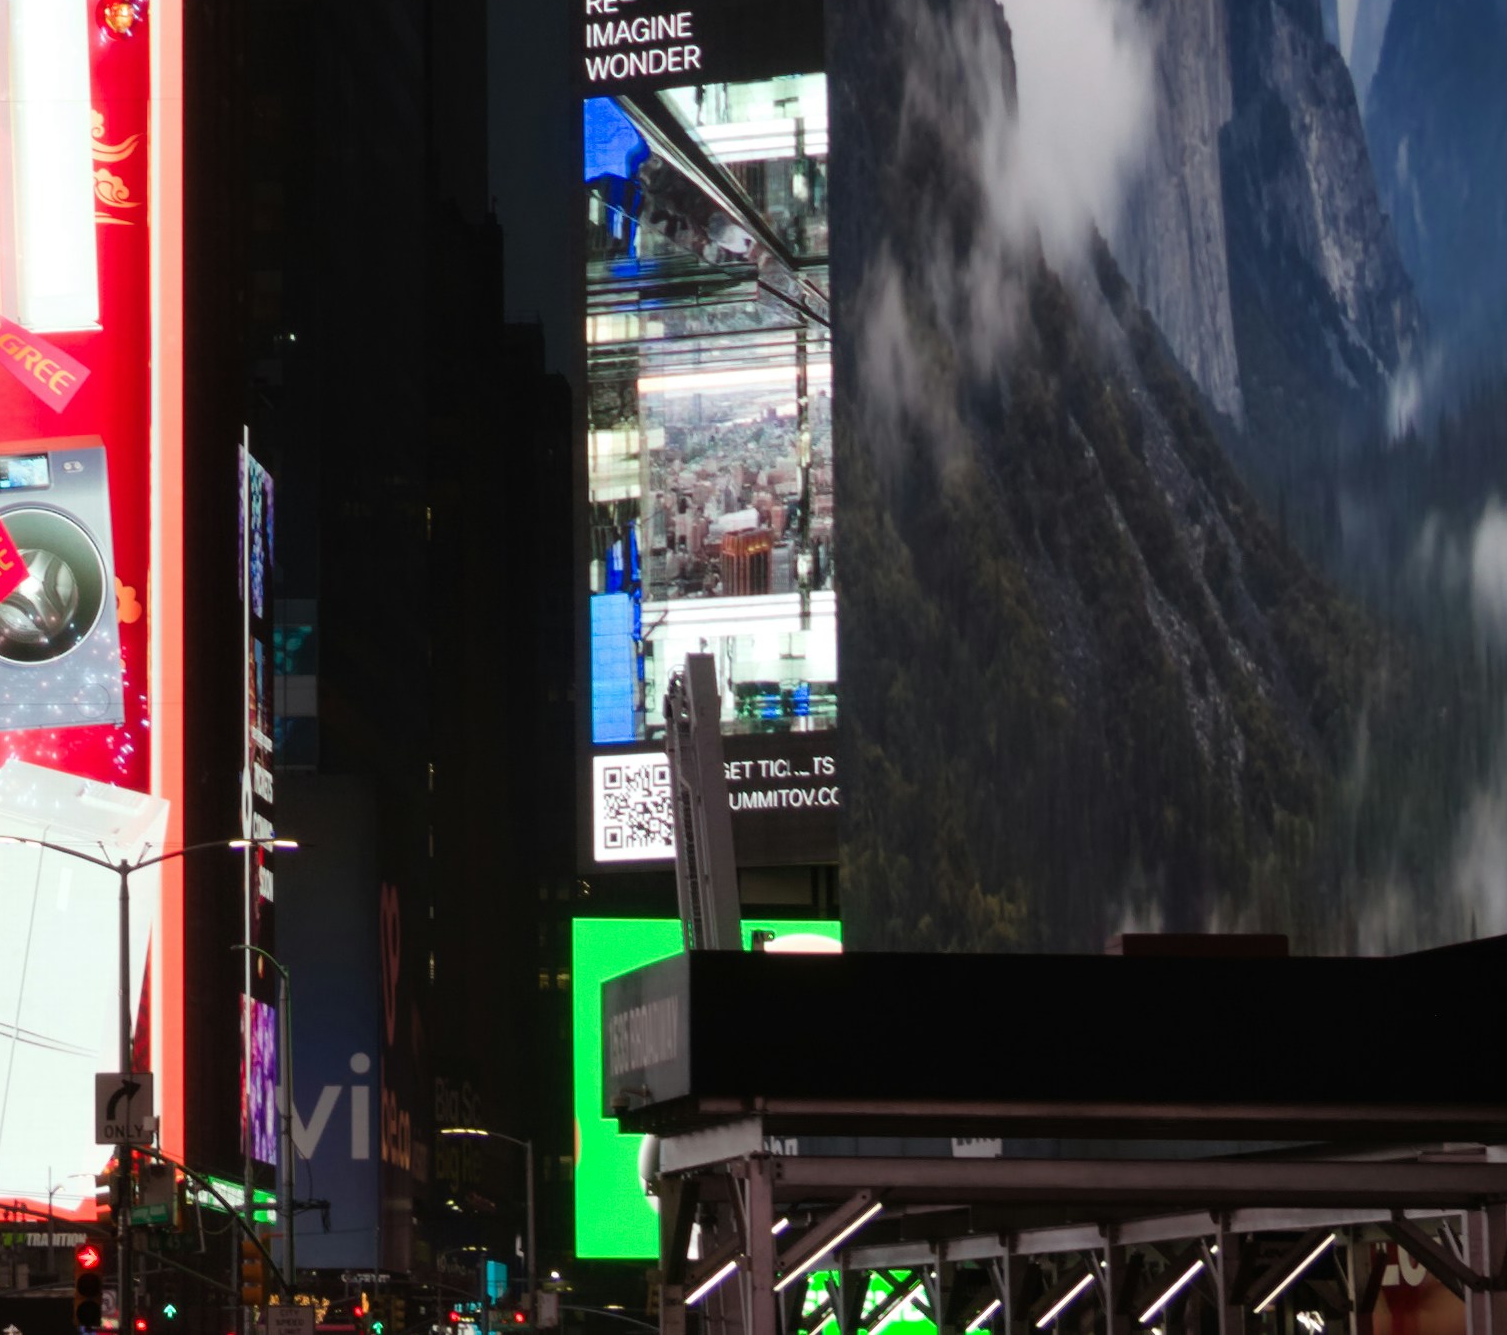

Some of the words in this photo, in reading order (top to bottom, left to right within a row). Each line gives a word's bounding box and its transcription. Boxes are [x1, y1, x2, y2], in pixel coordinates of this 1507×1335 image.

[585, 12, 693, 50] IMAGINE
[585, 45, 702, 82] WONDER
[757, 756, 835, 778] TICTS
[104, 1125, 145, 1140] ONLY
